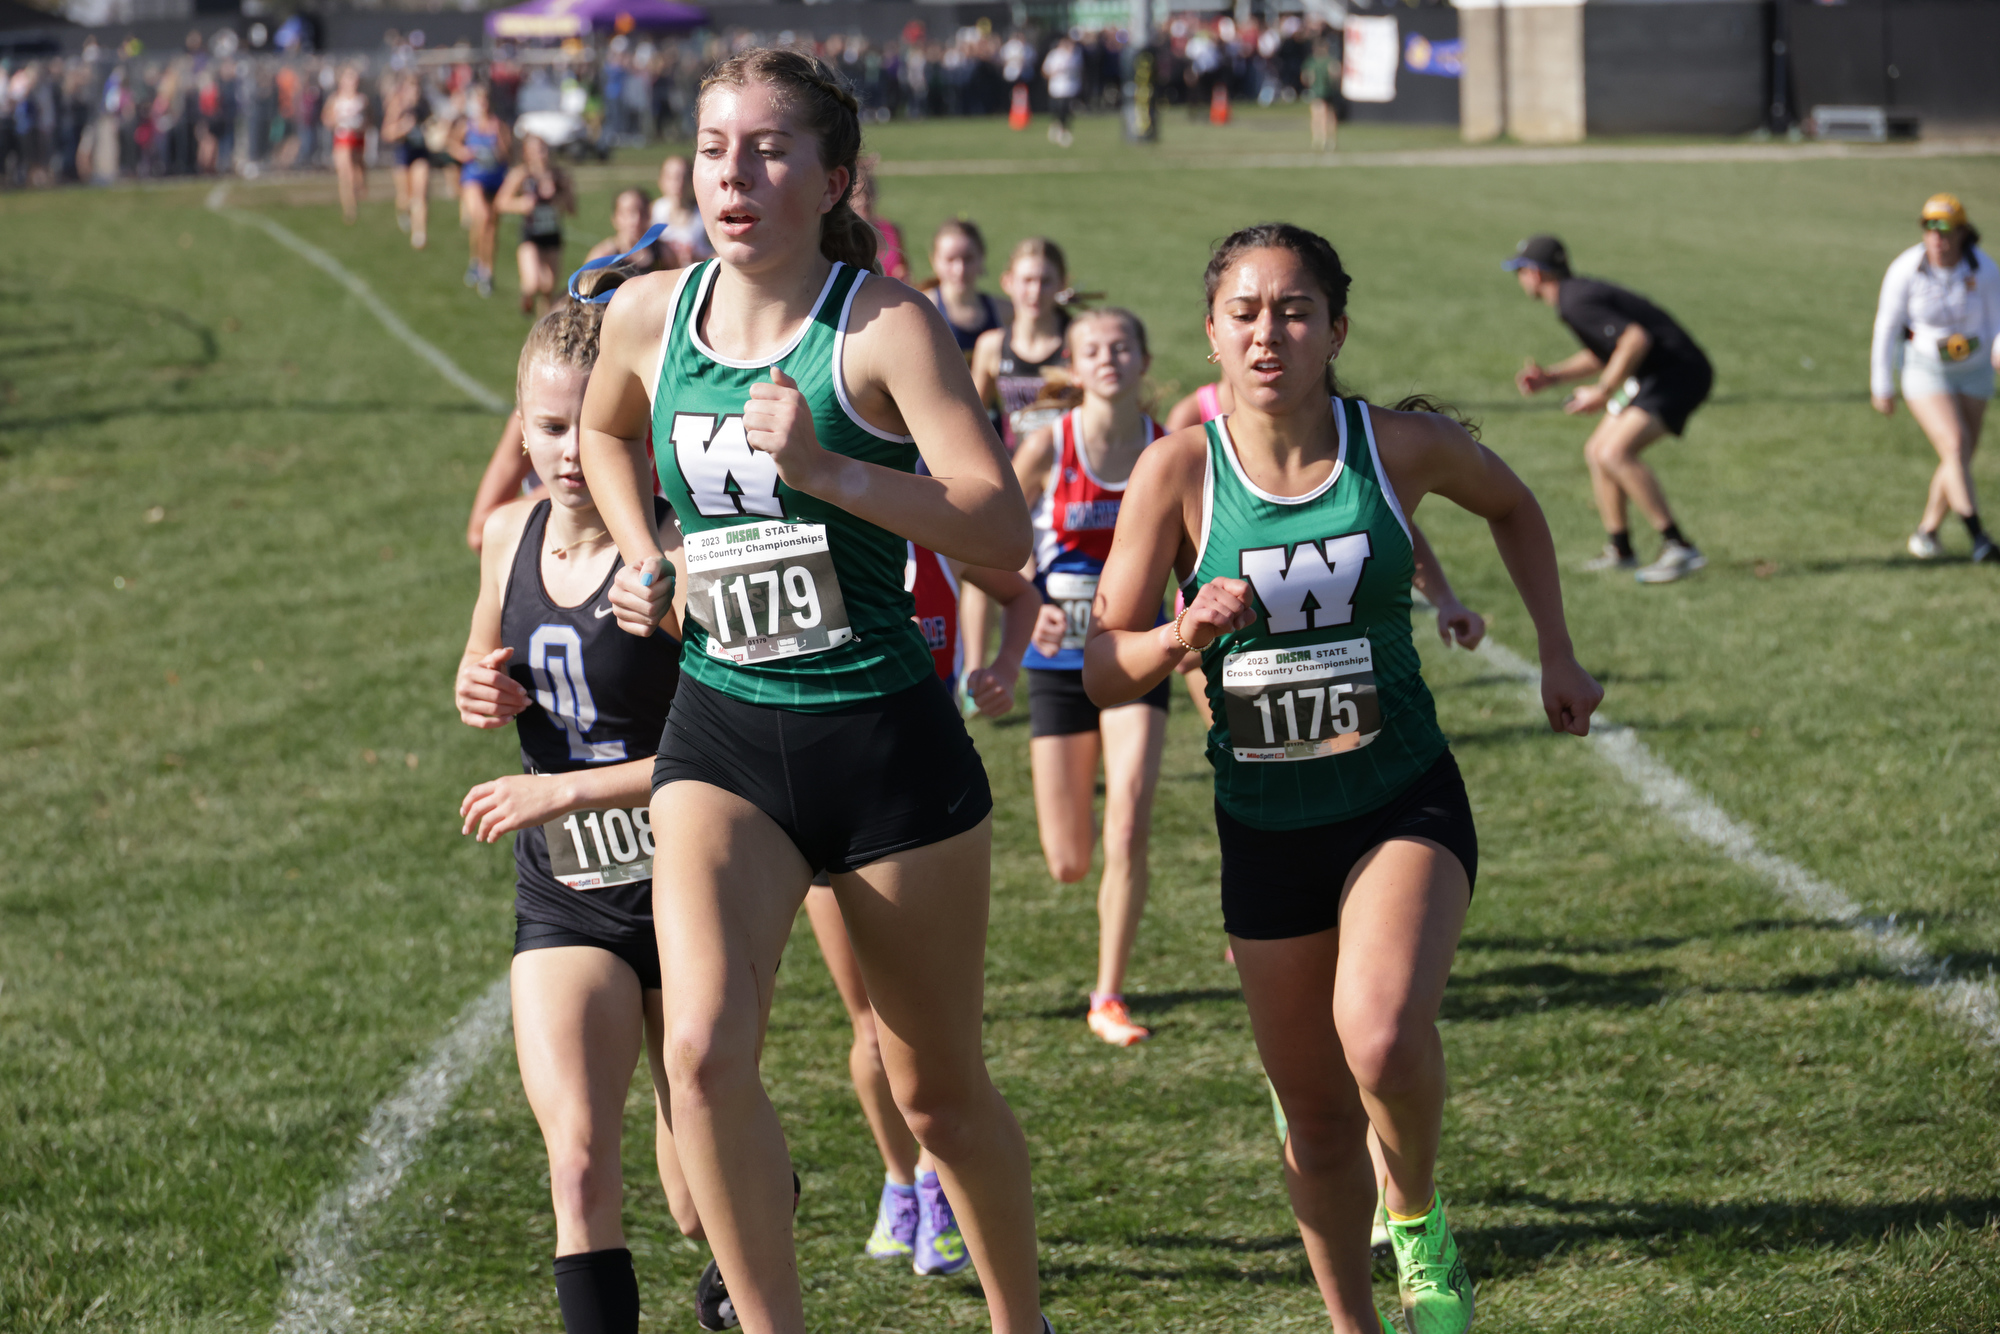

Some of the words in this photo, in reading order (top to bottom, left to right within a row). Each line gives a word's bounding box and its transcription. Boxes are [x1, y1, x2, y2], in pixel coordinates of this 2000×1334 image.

[687, 553, 707, 563] Cross
[708, 547, 743, 559] Country
[745, 533, 824, 553] Championships
[701, 536, 720, 547] 2023
[726, 527, 761, 544] OHSAA
[764, 524, 798, 537] STATE
[1239, 529, 1375, 636] W
[708, 566, 822, 643] 1179
[747, 637, 767, 645] 01179
[1247, 657, 1269, 665] 2023
[1275, 650, 1311, 664] OHSAA
[1316, 647, 1348, 658] STATE
[1255, 667, 1293, 676] Country
[1296, 656, 1370, 672] Championships
[1253, 683, 1359, 744] 1175
[563, 807, 656, 869] 1108
